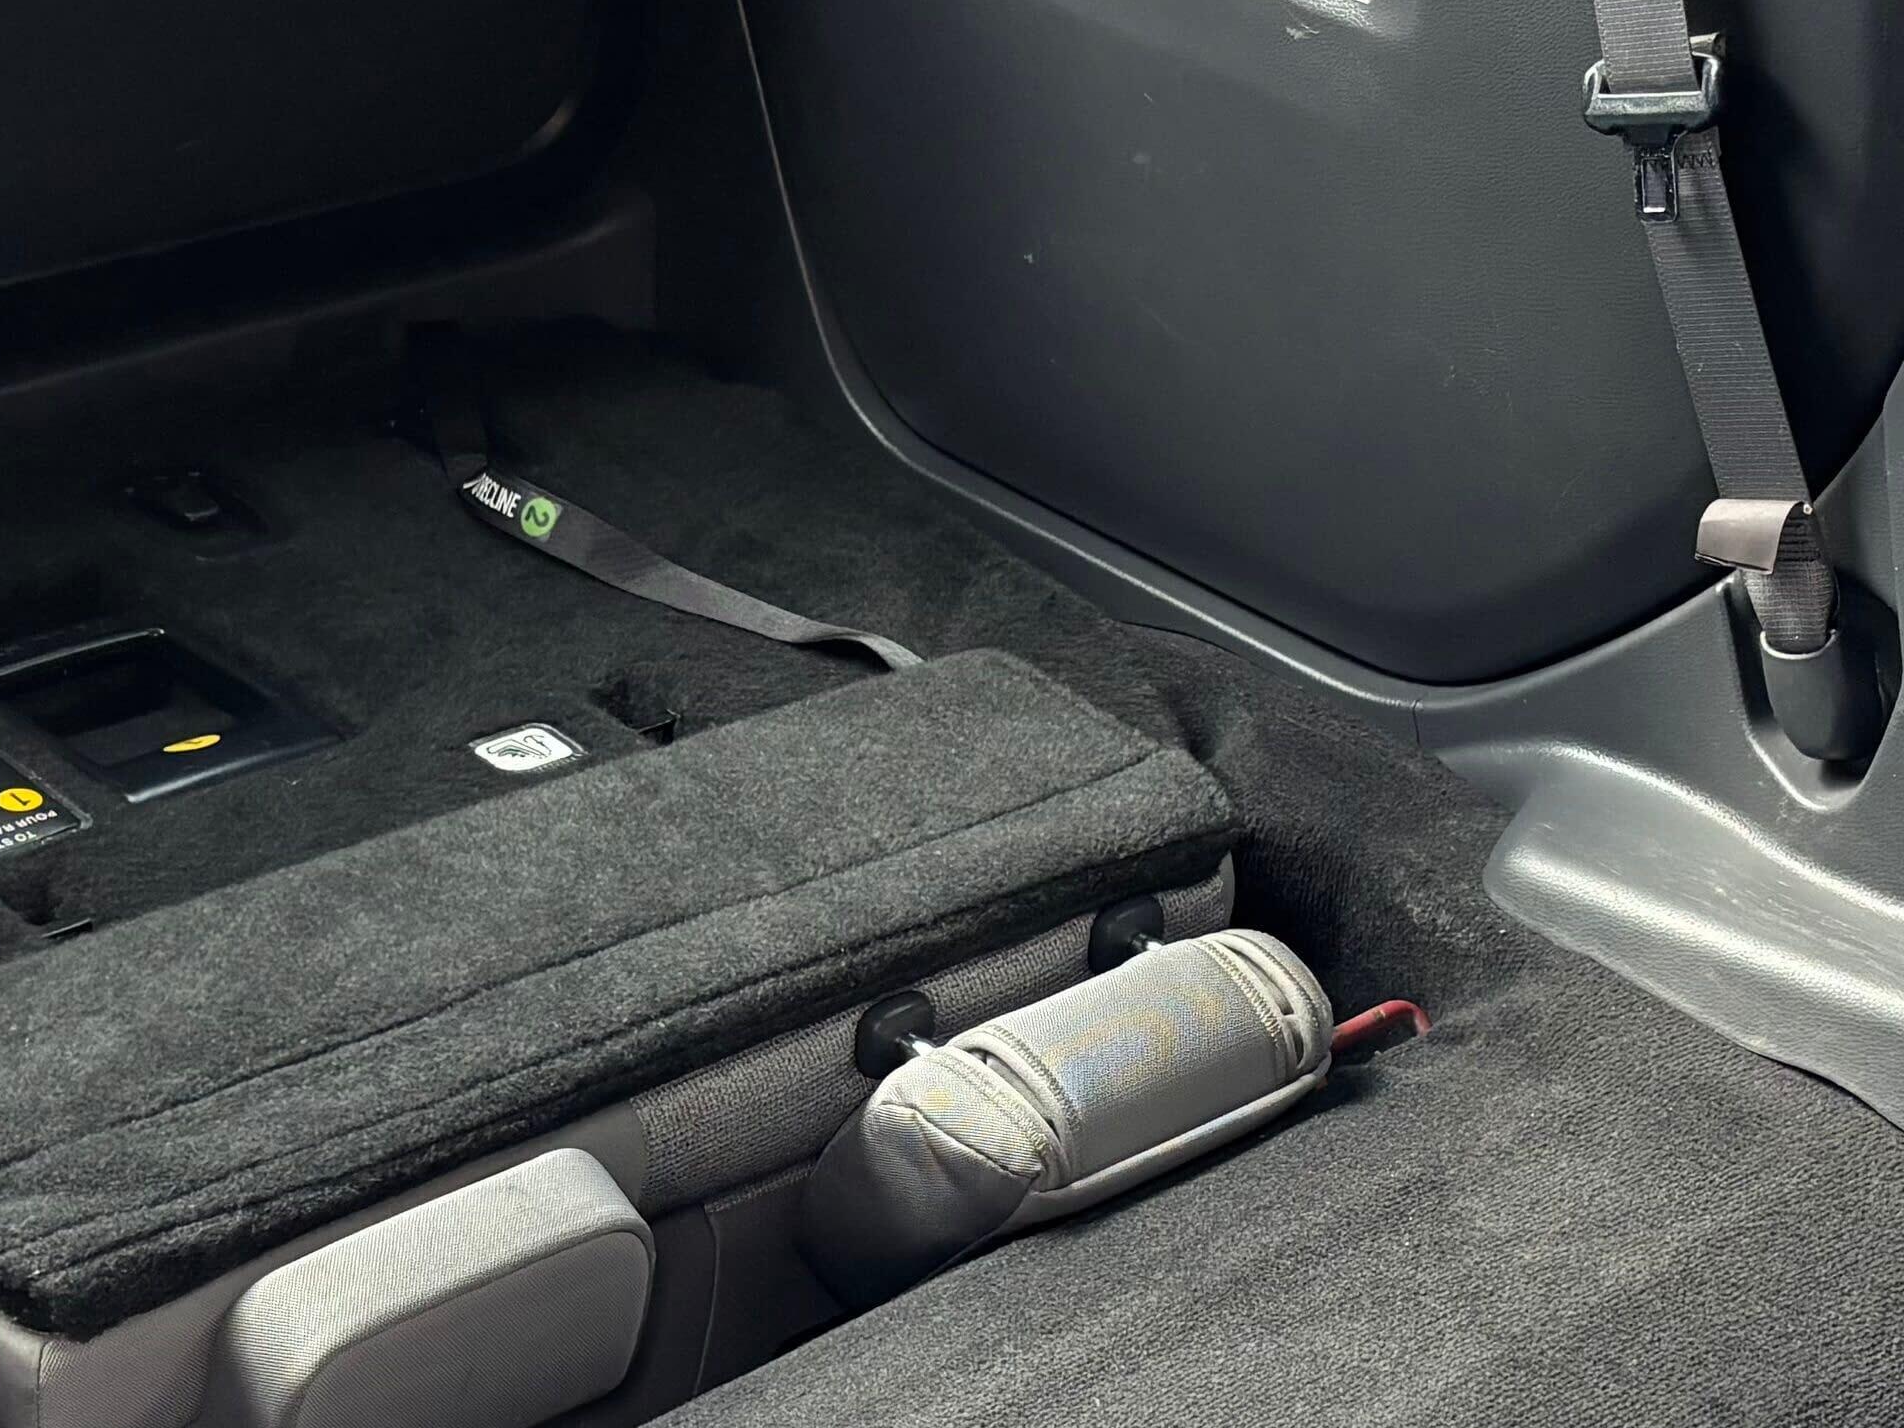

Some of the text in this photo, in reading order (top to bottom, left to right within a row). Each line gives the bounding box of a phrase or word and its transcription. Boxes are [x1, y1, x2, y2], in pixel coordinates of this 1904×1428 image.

[525, 505, 550, 527] 2
[9, 792, 31, 807] 1
[15, 810, 58, 827] POUR
[14, 830, 37, 842] TO
